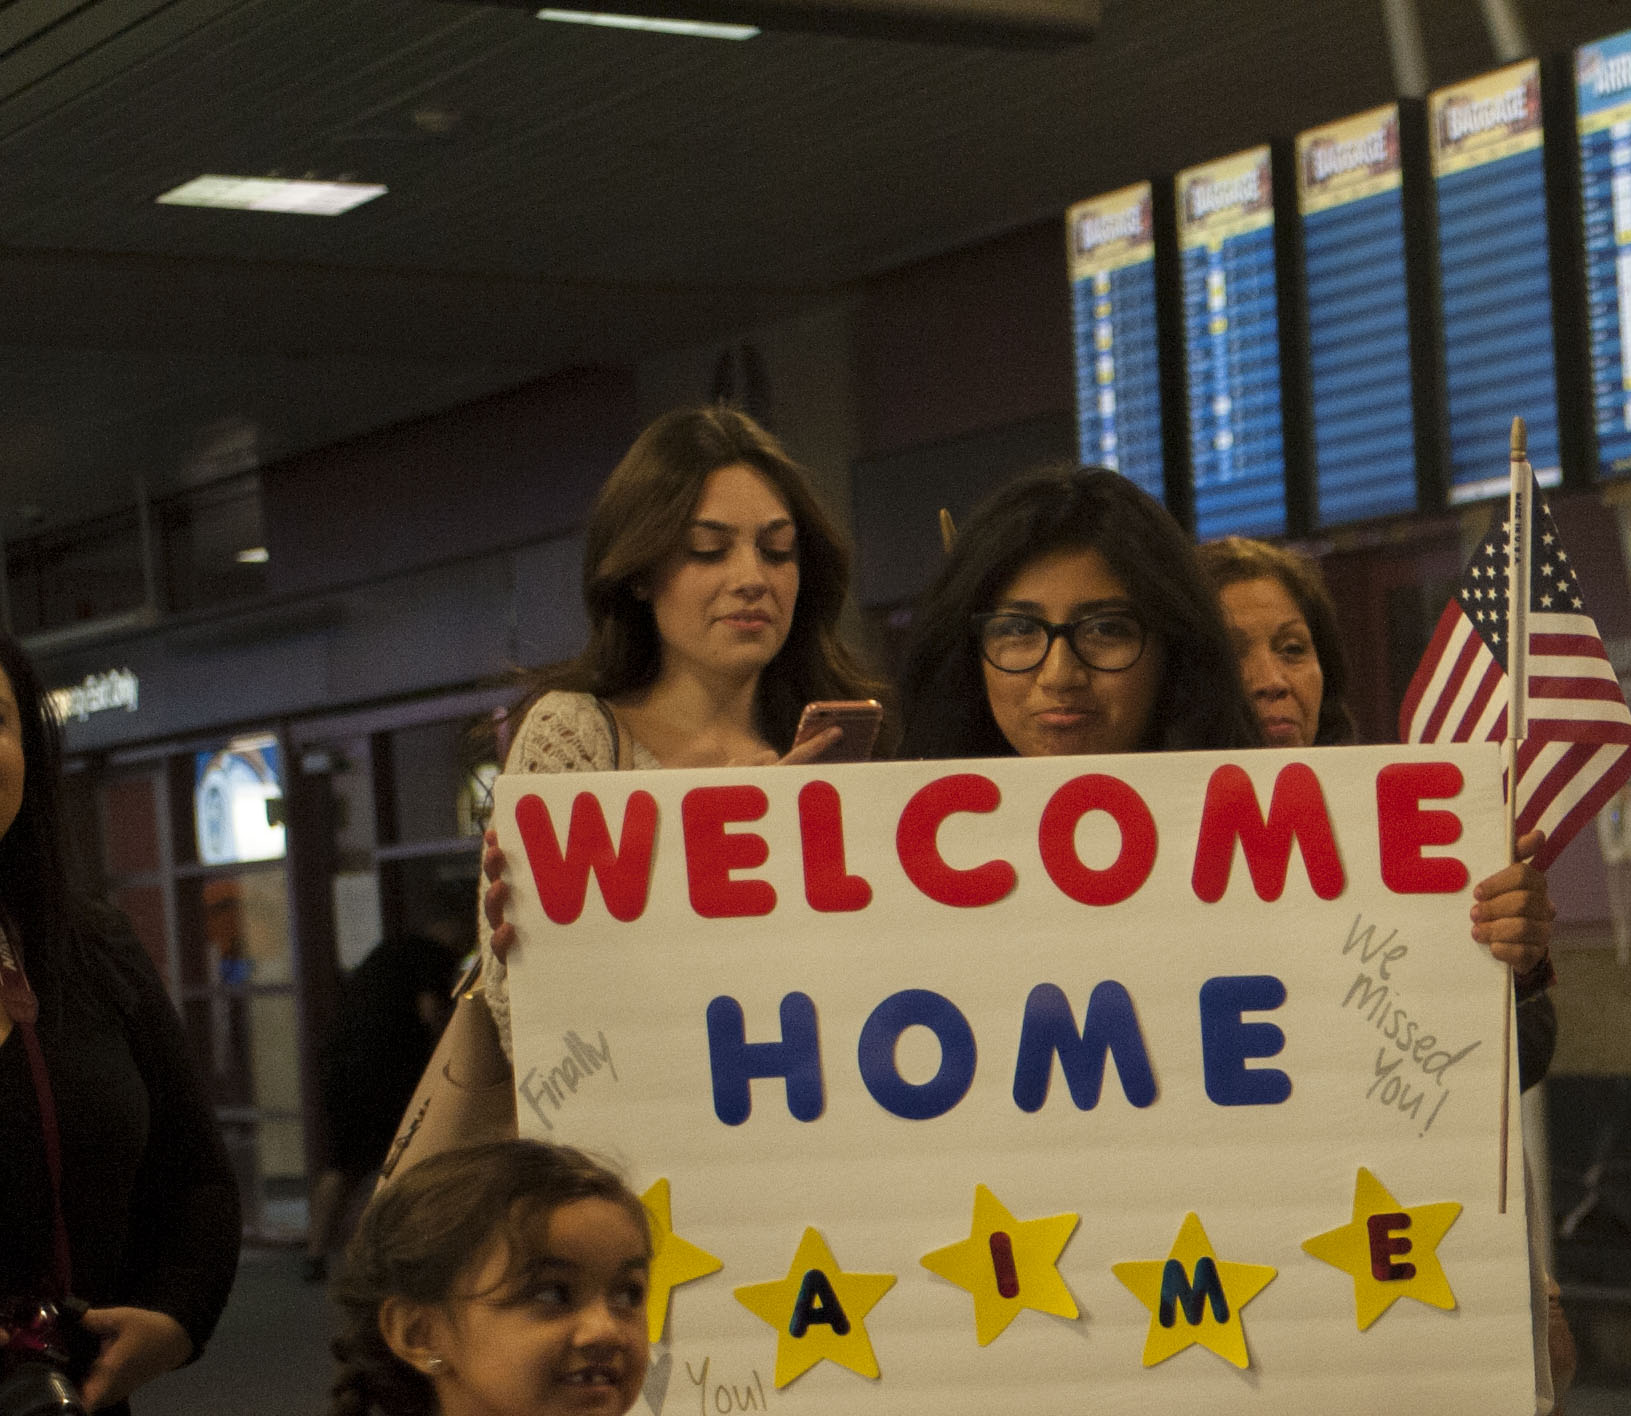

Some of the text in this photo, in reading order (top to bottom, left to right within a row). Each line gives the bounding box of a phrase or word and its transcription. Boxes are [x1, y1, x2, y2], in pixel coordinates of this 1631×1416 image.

[515, 761, 1470, 925] WELCOME
[1342, 913, 1409, 981] We
[518, 1030, 619, 1131] Finally
[705, 975, 1294, 1127] HOME
